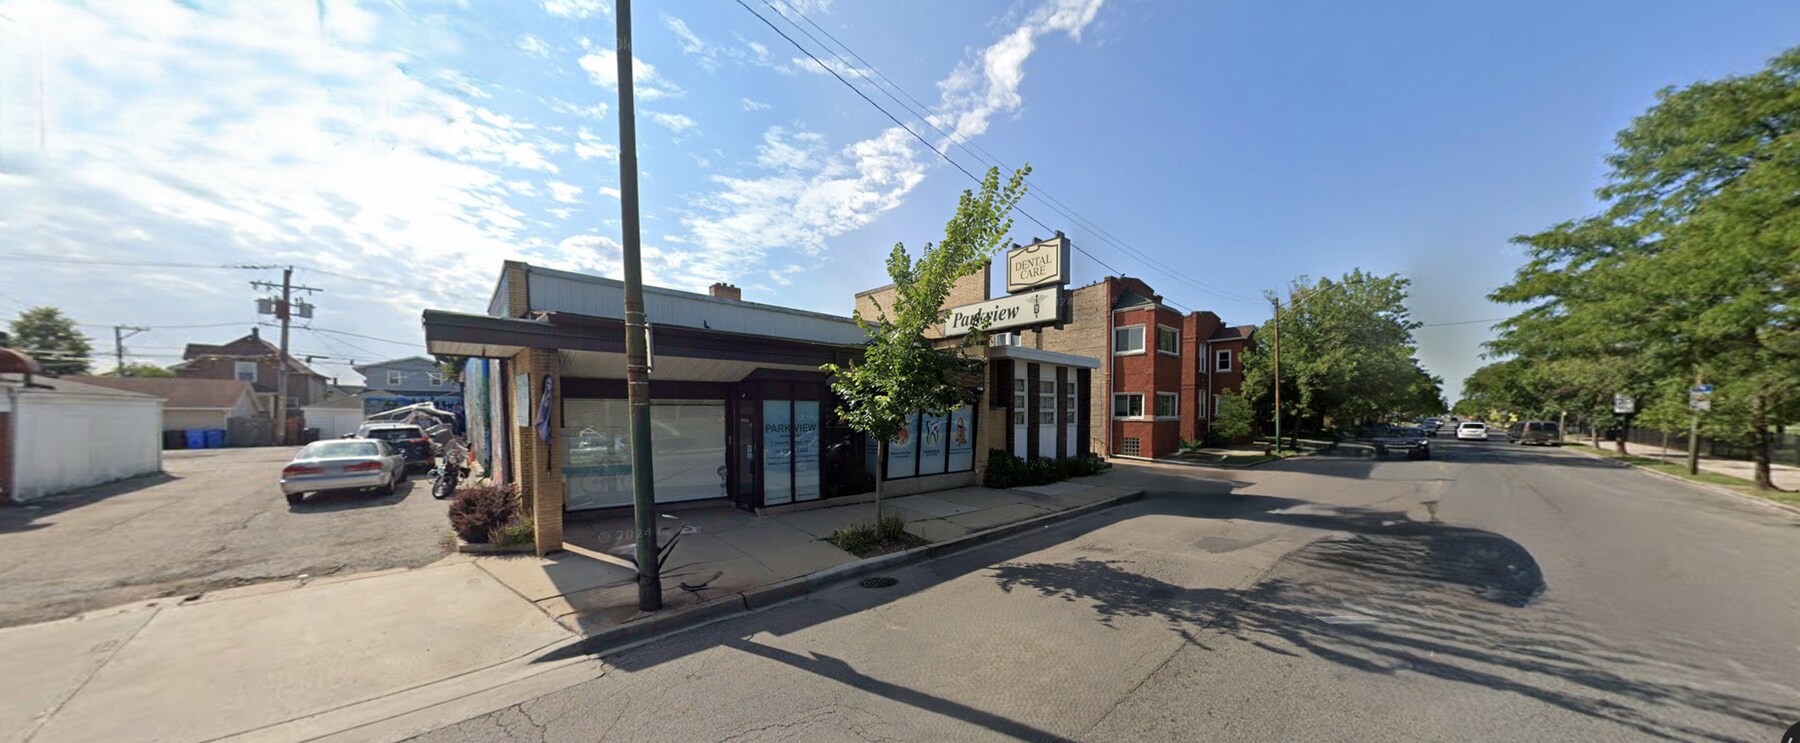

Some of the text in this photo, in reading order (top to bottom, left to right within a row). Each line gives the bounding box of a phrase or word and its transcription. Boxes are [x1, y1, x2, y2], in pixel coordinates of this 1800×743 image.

[1015, 254, 1052, 271] DENTAL
[1020, 265, 1046, 280] CARE
[952, 305, 1020, 328] Parkview
